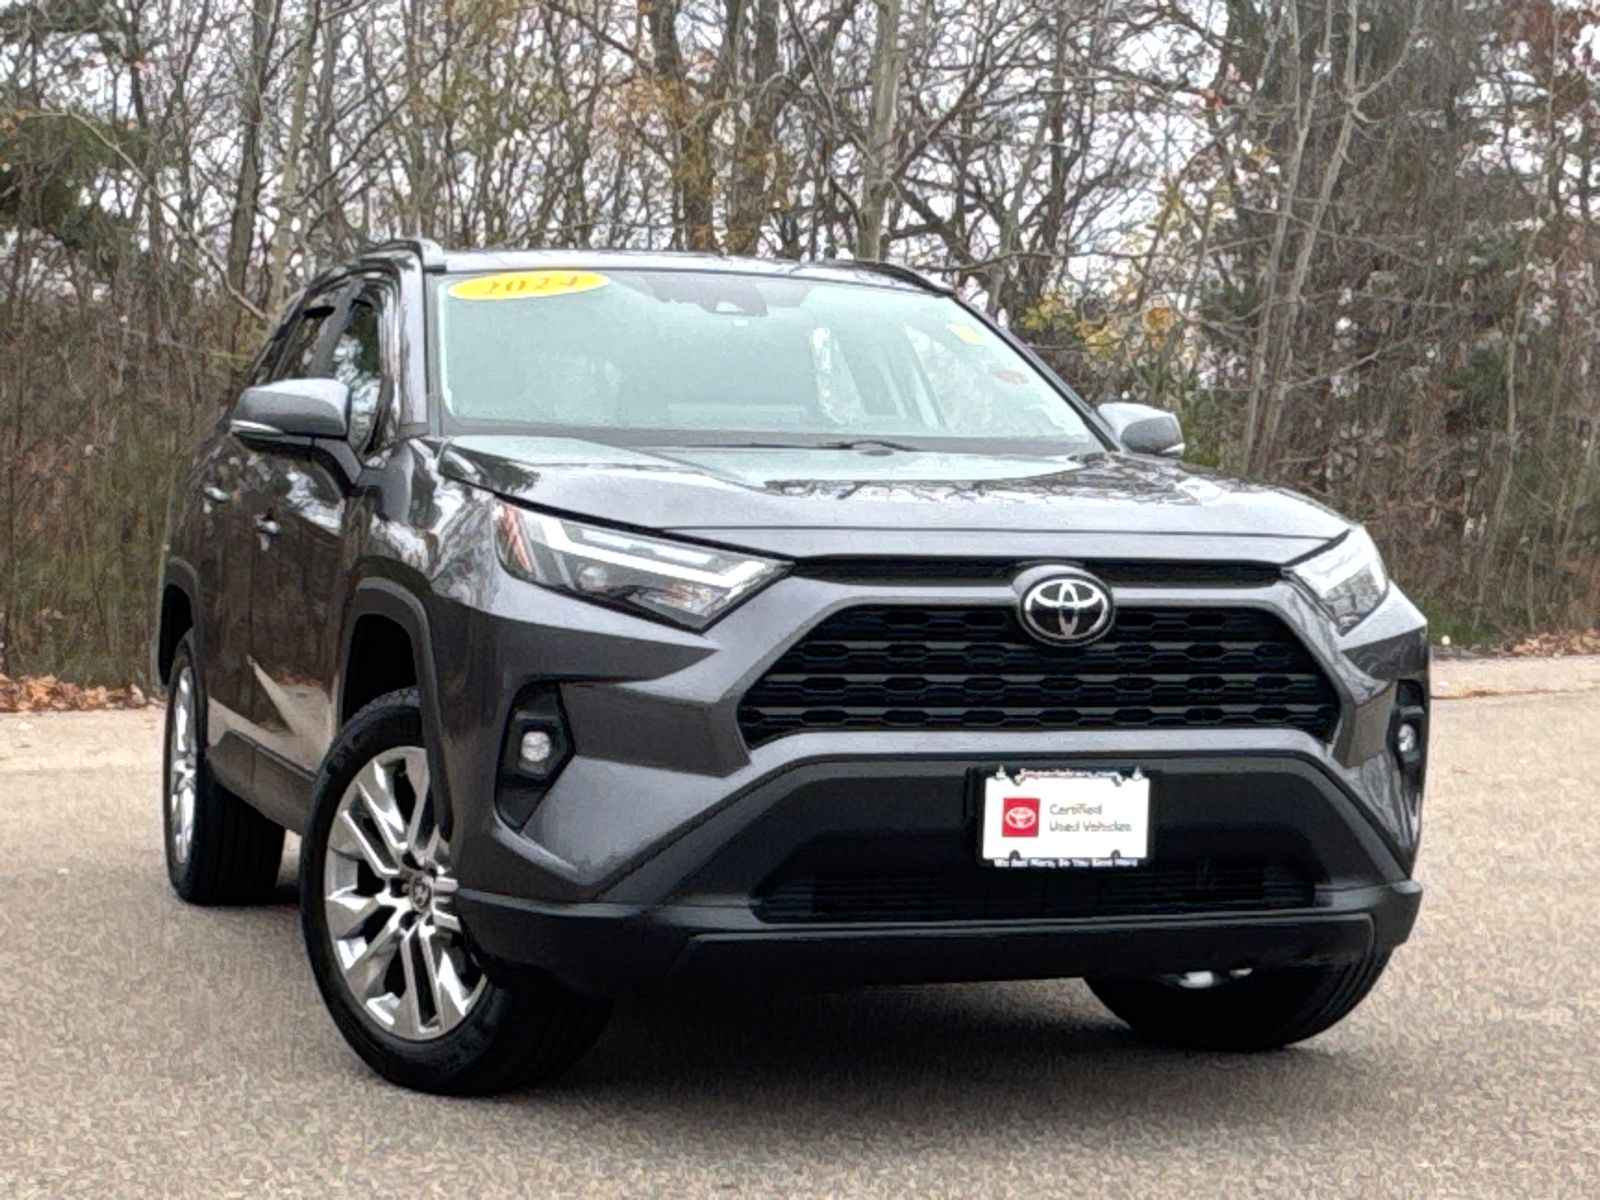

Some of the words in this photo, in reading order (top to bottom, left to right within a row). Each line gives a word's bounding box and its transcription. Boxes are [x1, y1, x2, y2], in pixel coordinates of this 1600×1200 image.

[483, 275, 579, 295] 2024
[1049, 803, 1103, 815] Certified
[1049, 819, 1080, 832] Used
[1083, 819, 1132, 832] Vehicles
